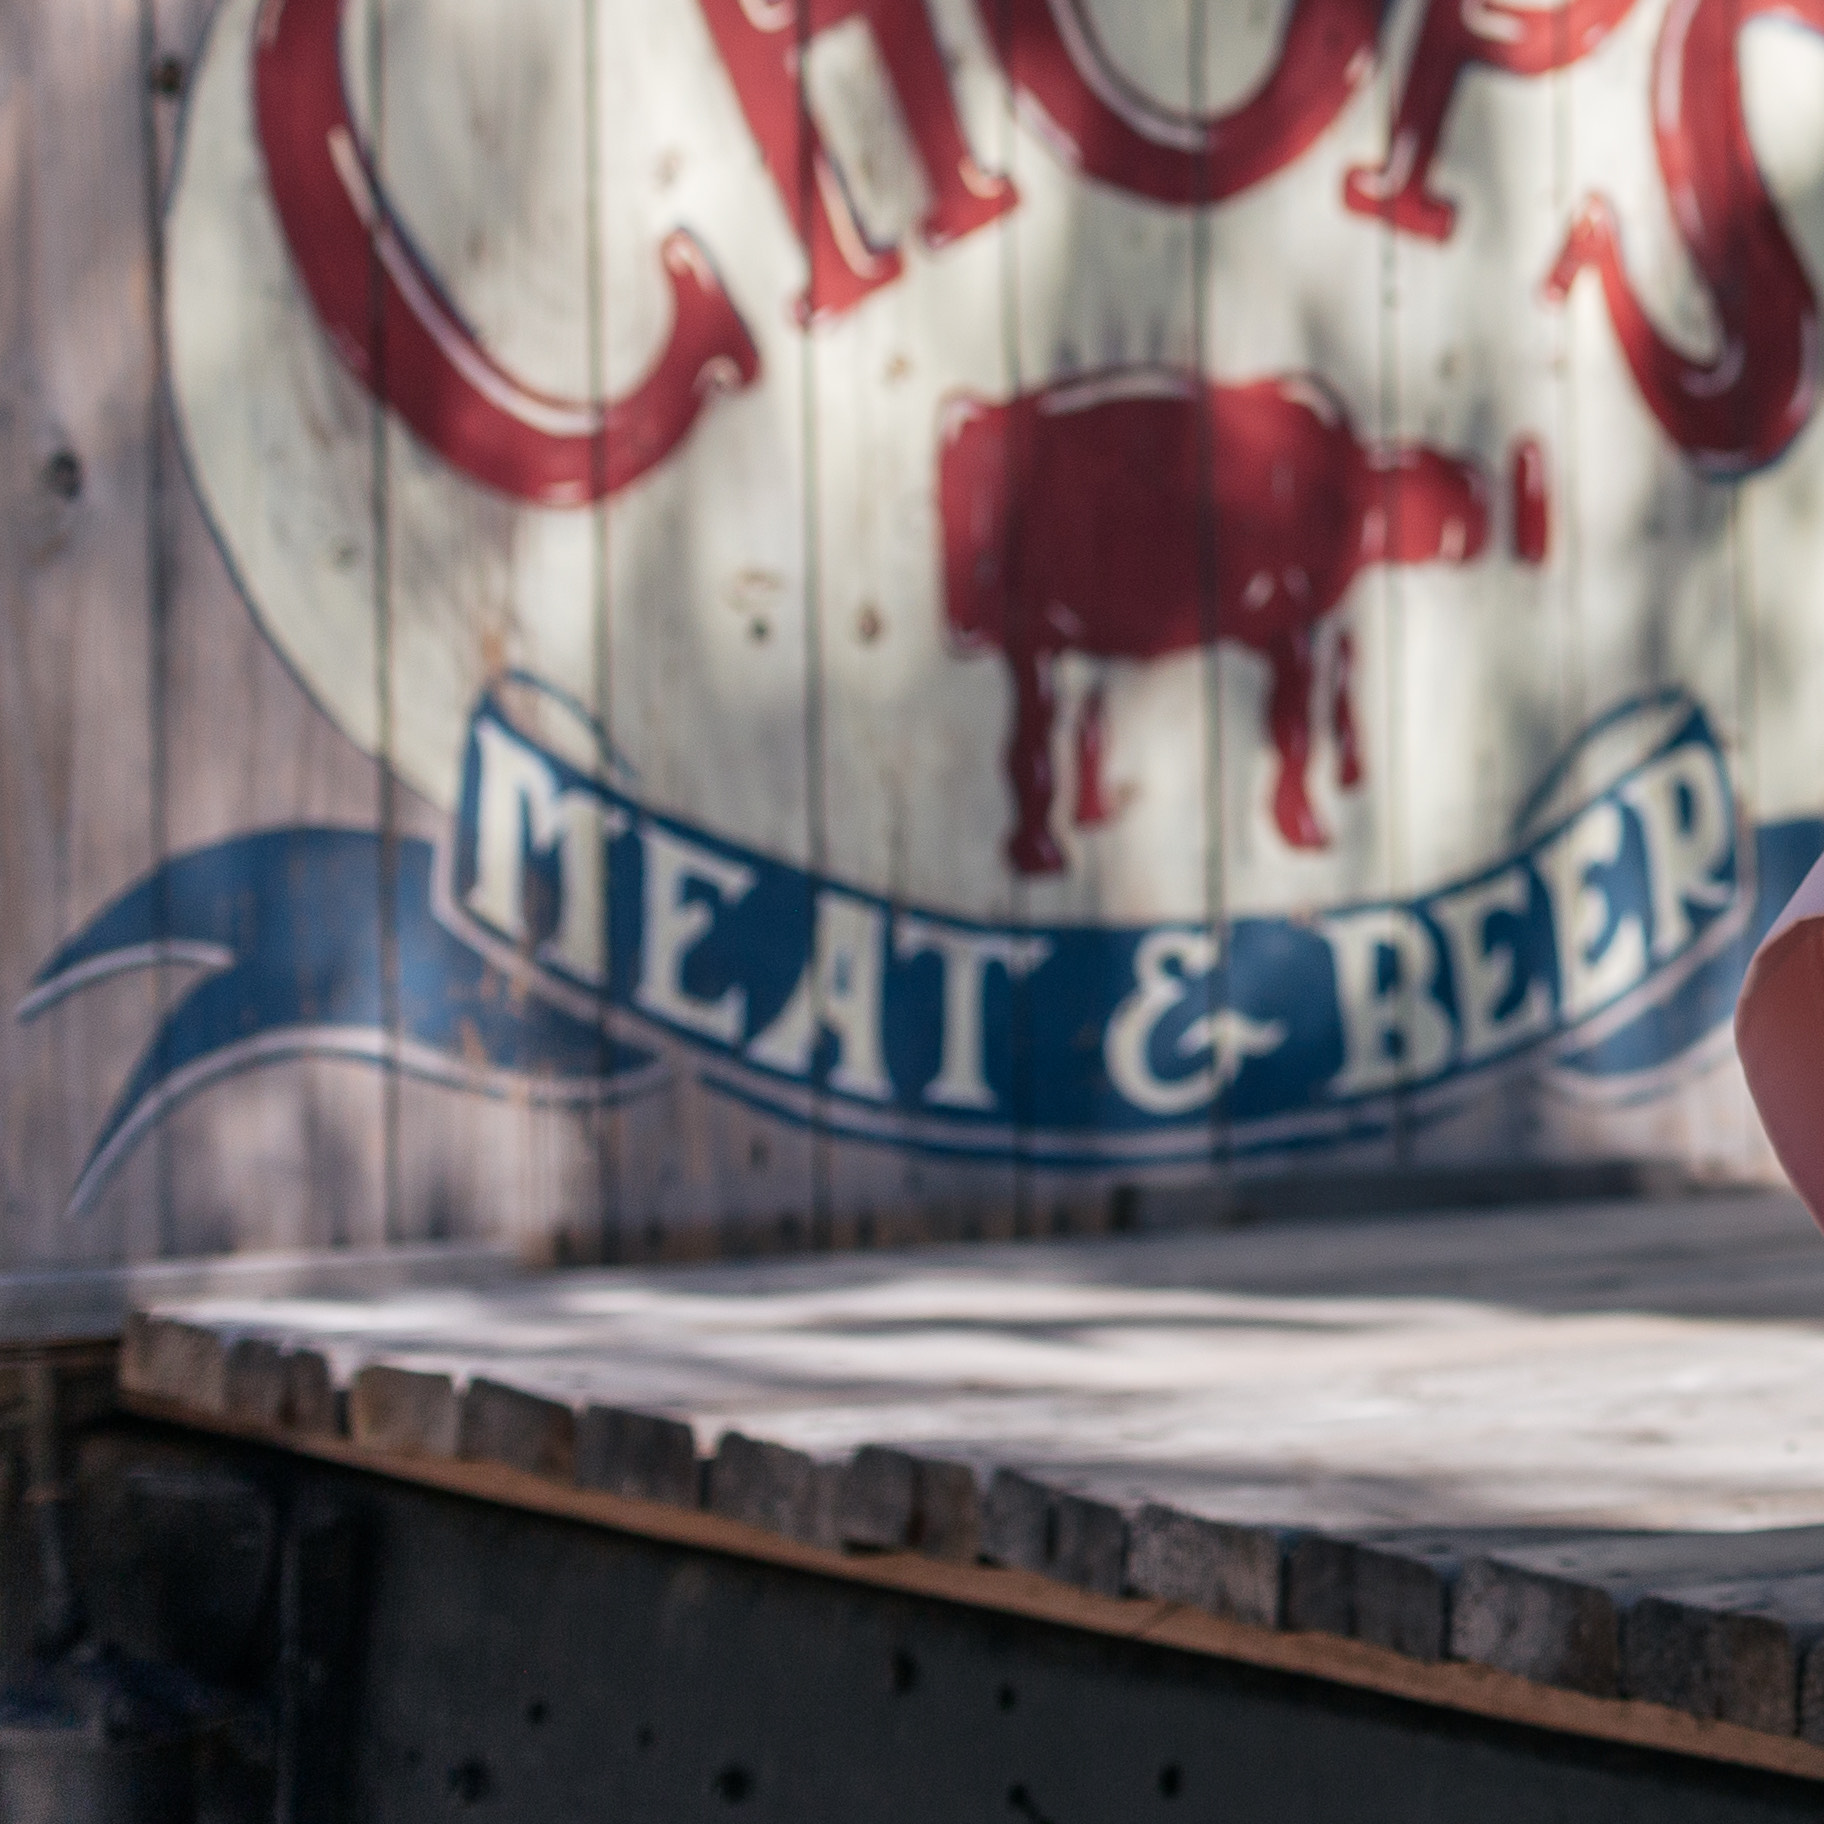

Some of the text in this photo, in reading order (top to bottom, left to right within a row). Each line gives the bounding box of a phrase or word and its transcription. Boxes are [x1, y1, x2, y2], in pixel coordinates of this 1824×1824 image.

[463, 716, 1742, 1116] MEAT & BEER
